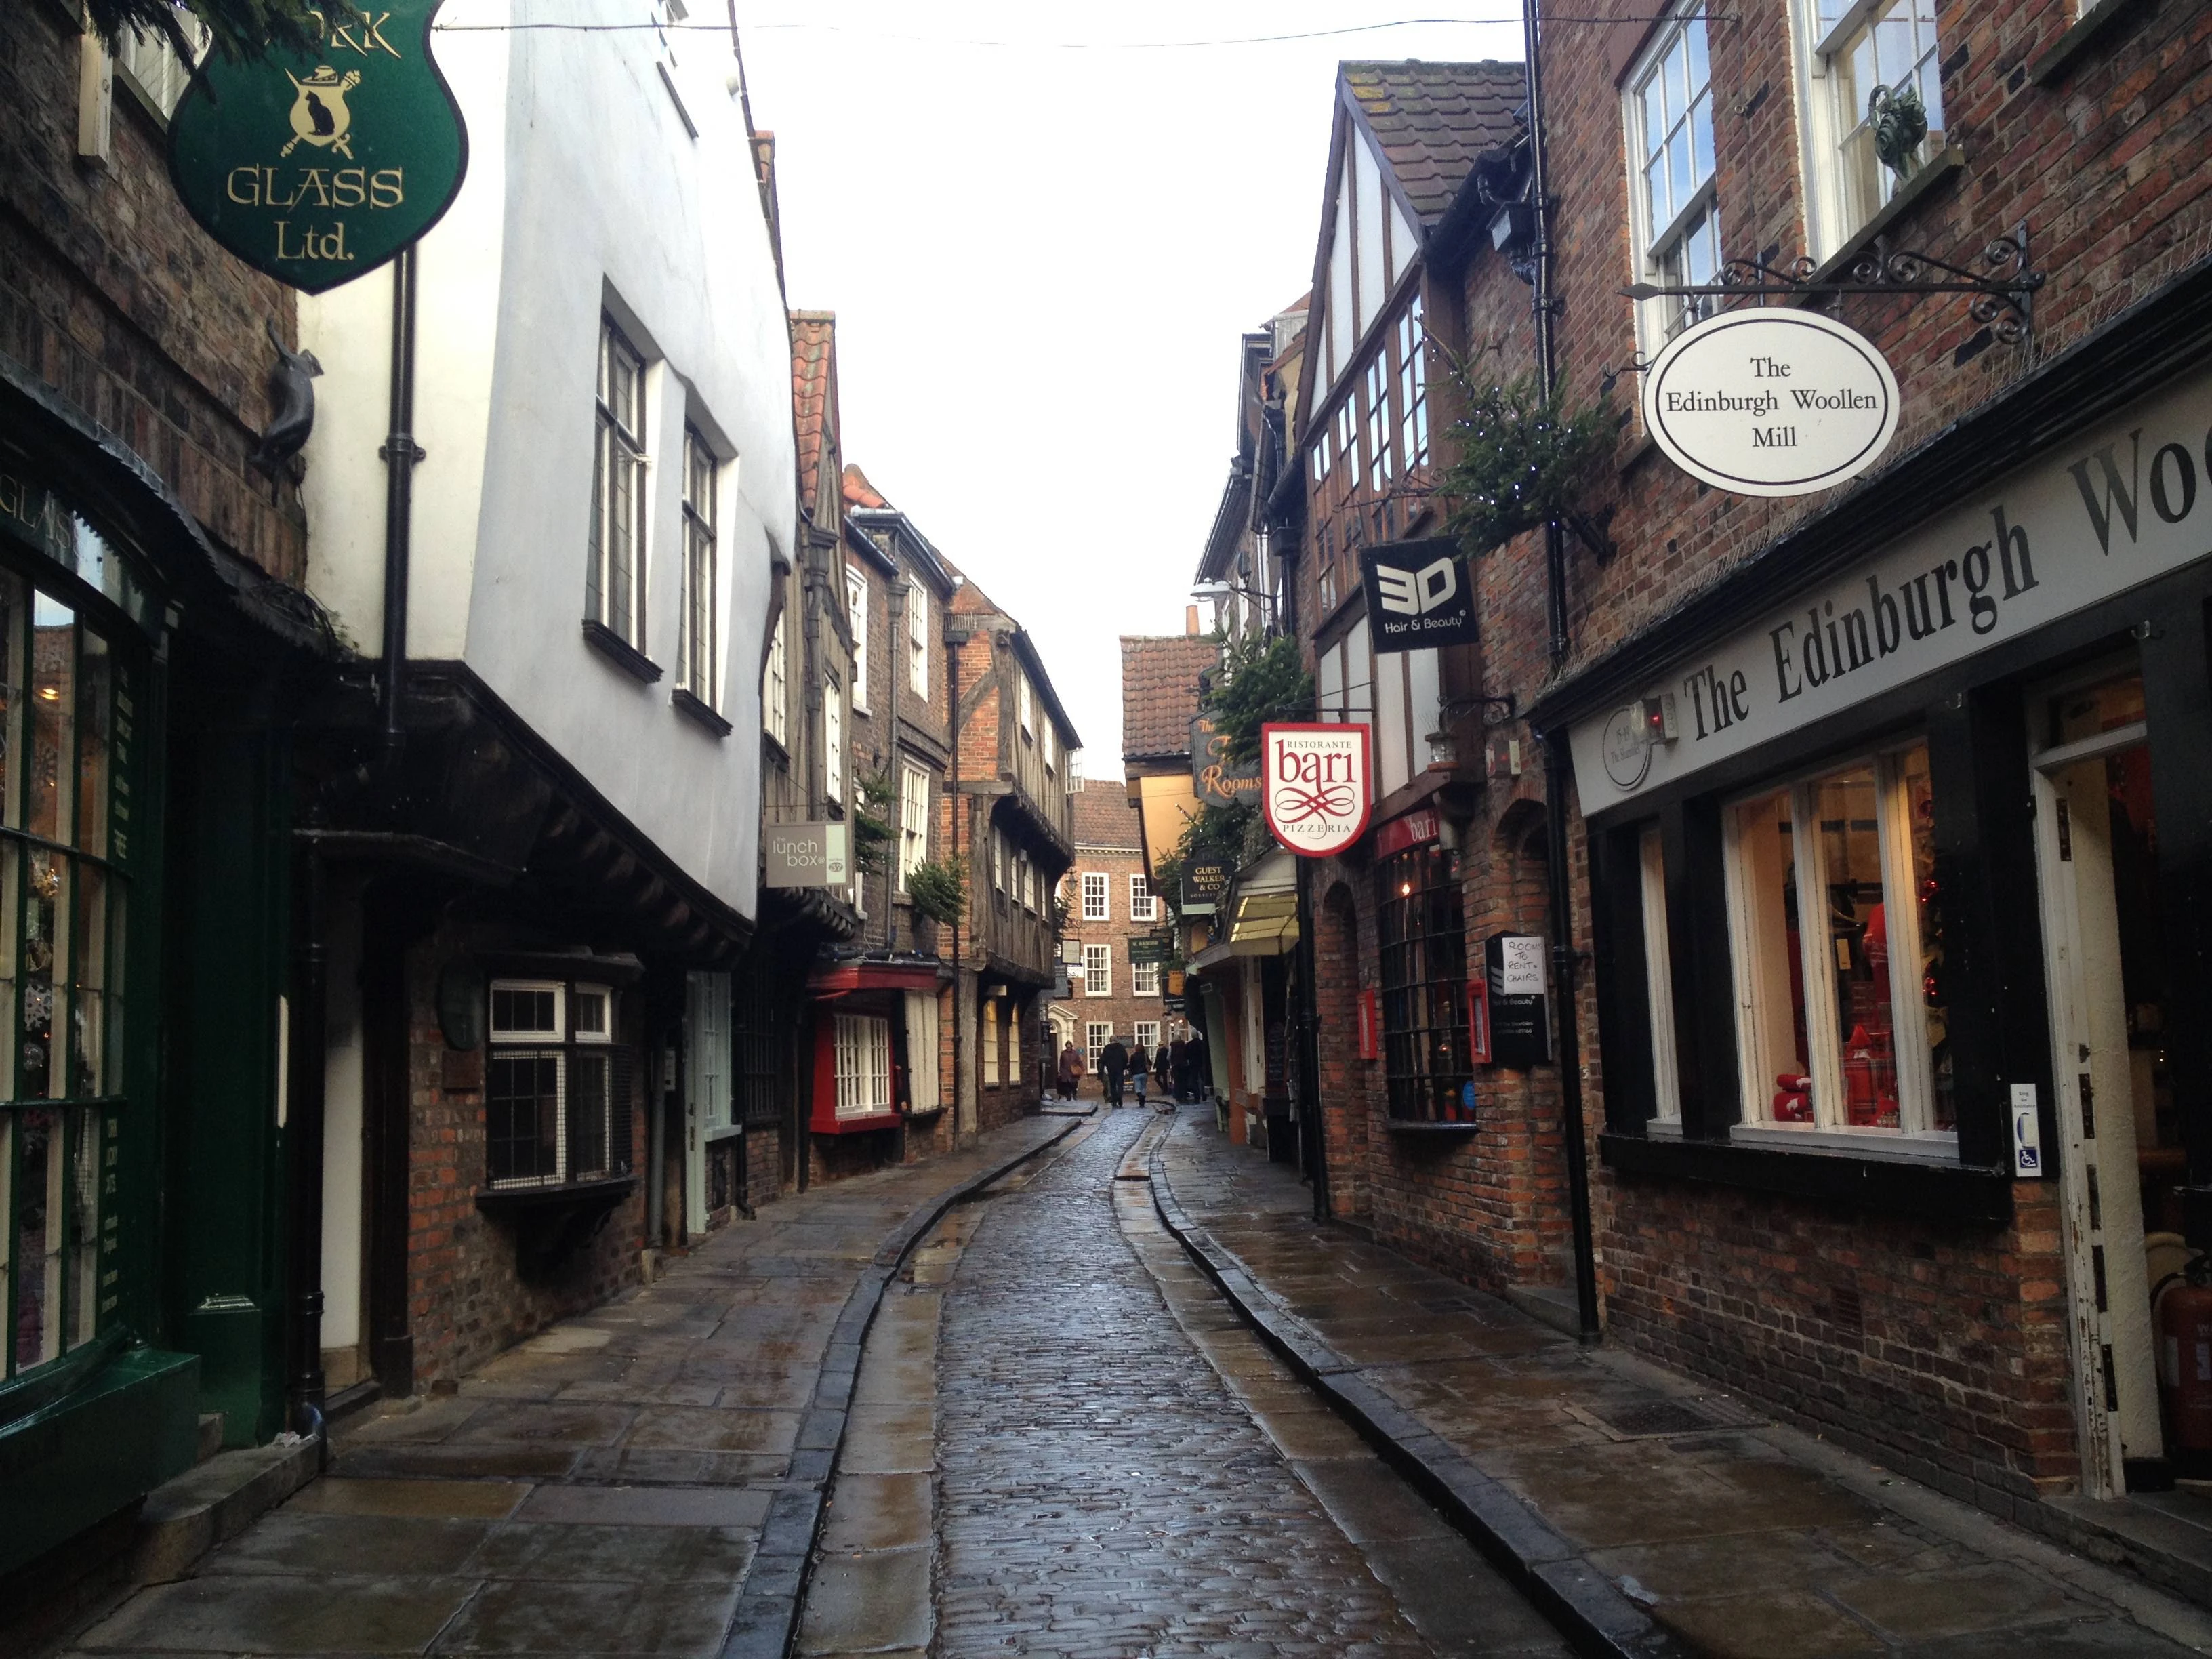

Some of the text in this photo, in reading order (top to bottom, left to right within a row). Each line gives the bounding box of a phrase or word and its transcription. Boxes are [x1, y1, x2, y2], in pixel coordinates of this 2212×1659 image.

[226, 163, 404, 211] GLASS
[274, 221, 355, 260] Ltd.
[1750, 357, 1791, 377] The
[1666, 388, 1878, 416] Edinburgh Woollen
[1752, 426, 1797, 447] Mill
[1376, 557, 1458, 616] 3D
[1683, 427, 2212, 743] The Edinburgh Wo
[1385, 616, 1462, 634] Hair & Beauty
[1197, 718, 1216, 733] The
[1287, 740, 1353, 750] RISTORANTE
[1275, 739, 1357, 783] bari
[1201, 764, 1262, 799] Rooms
[1283, 824, 1351, 833] PIZZERIA
[1409, 812, 1437, 842] bari
[773, 839, 818, 855] lunch
[1192, 875, 1225, 883] WALKER
[1195, 866, 1222, 874] GUEST
[1507, 973, 1539, 982] CHAIRS
